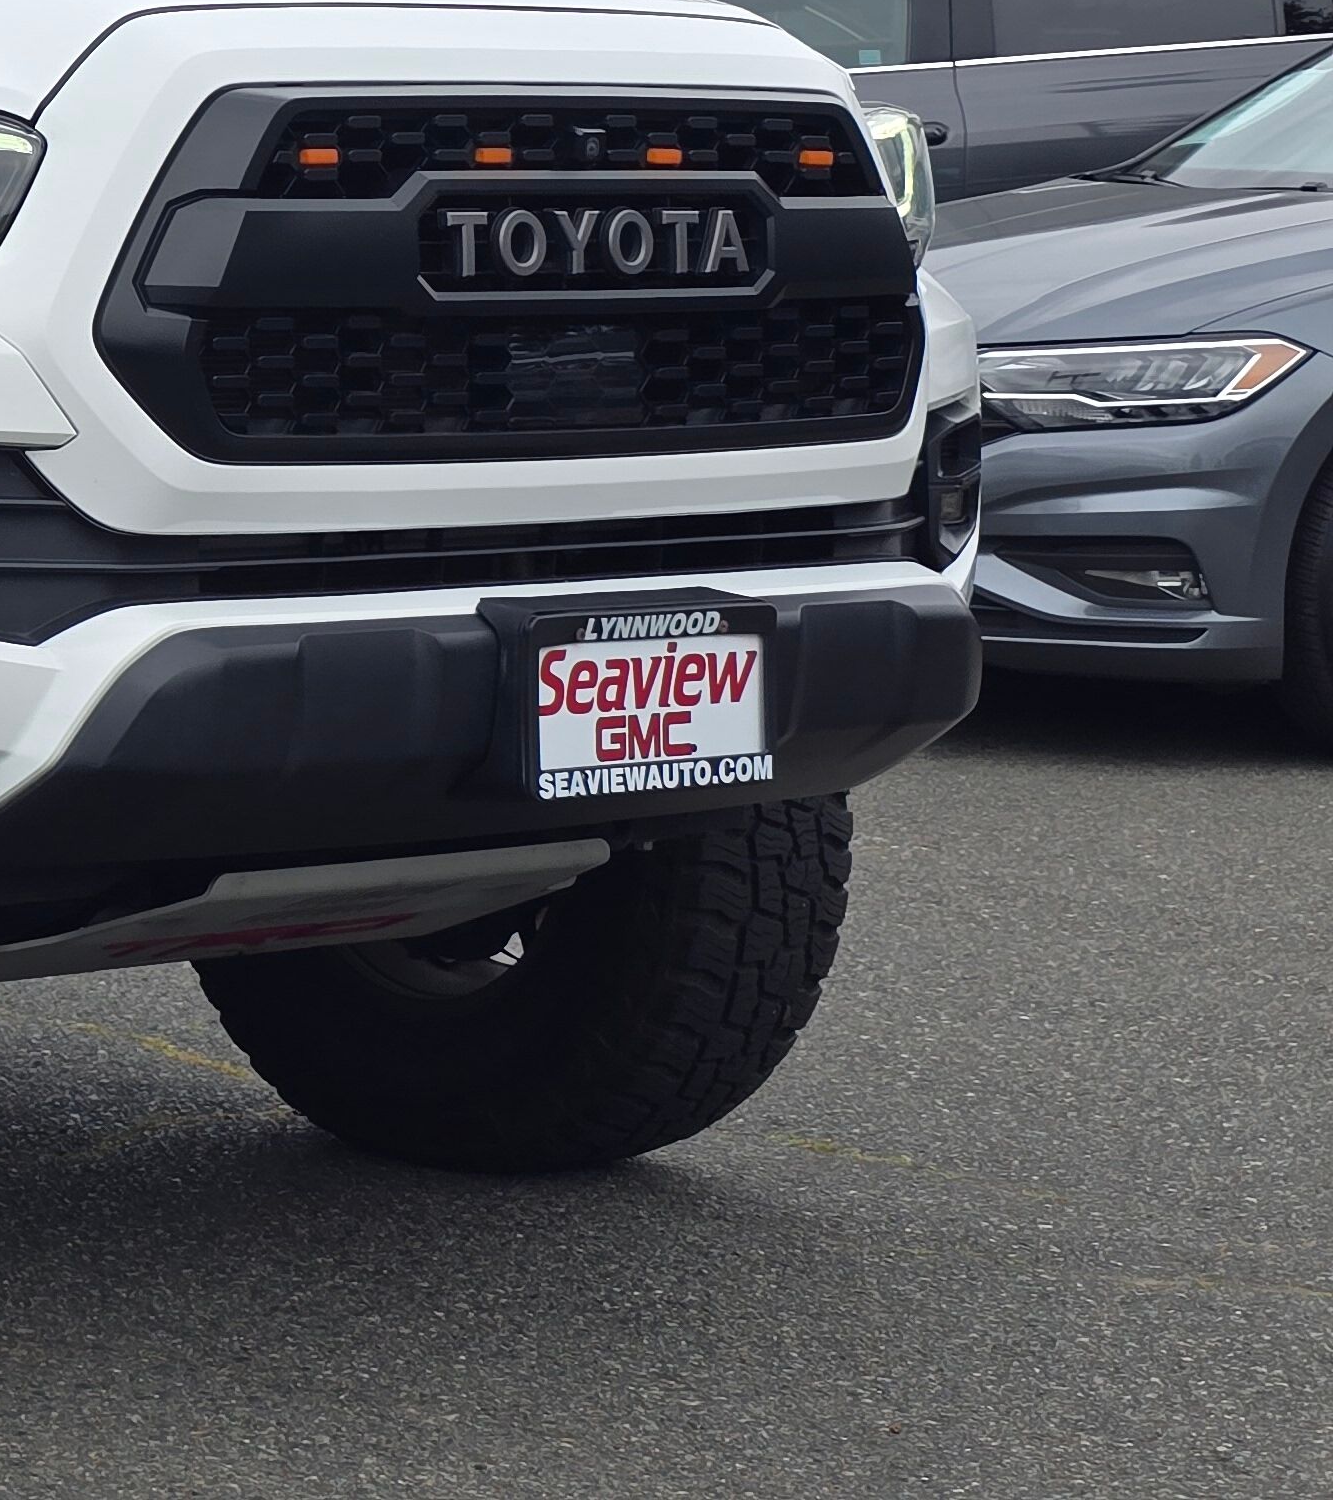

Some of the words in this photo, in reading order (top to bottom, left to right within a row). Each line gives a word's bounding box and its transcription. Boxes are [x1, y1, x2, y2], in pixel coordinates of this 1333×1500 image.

[442, 207, 749, 278] TOYOTA
[584, 611, 721, 641] LYNNWOOD
[539, 642, 757, 716] Seaview
[595, 711, 696, 762] GMC
[538, 754, 773, 800] SEAVIEWAUTO.COM
